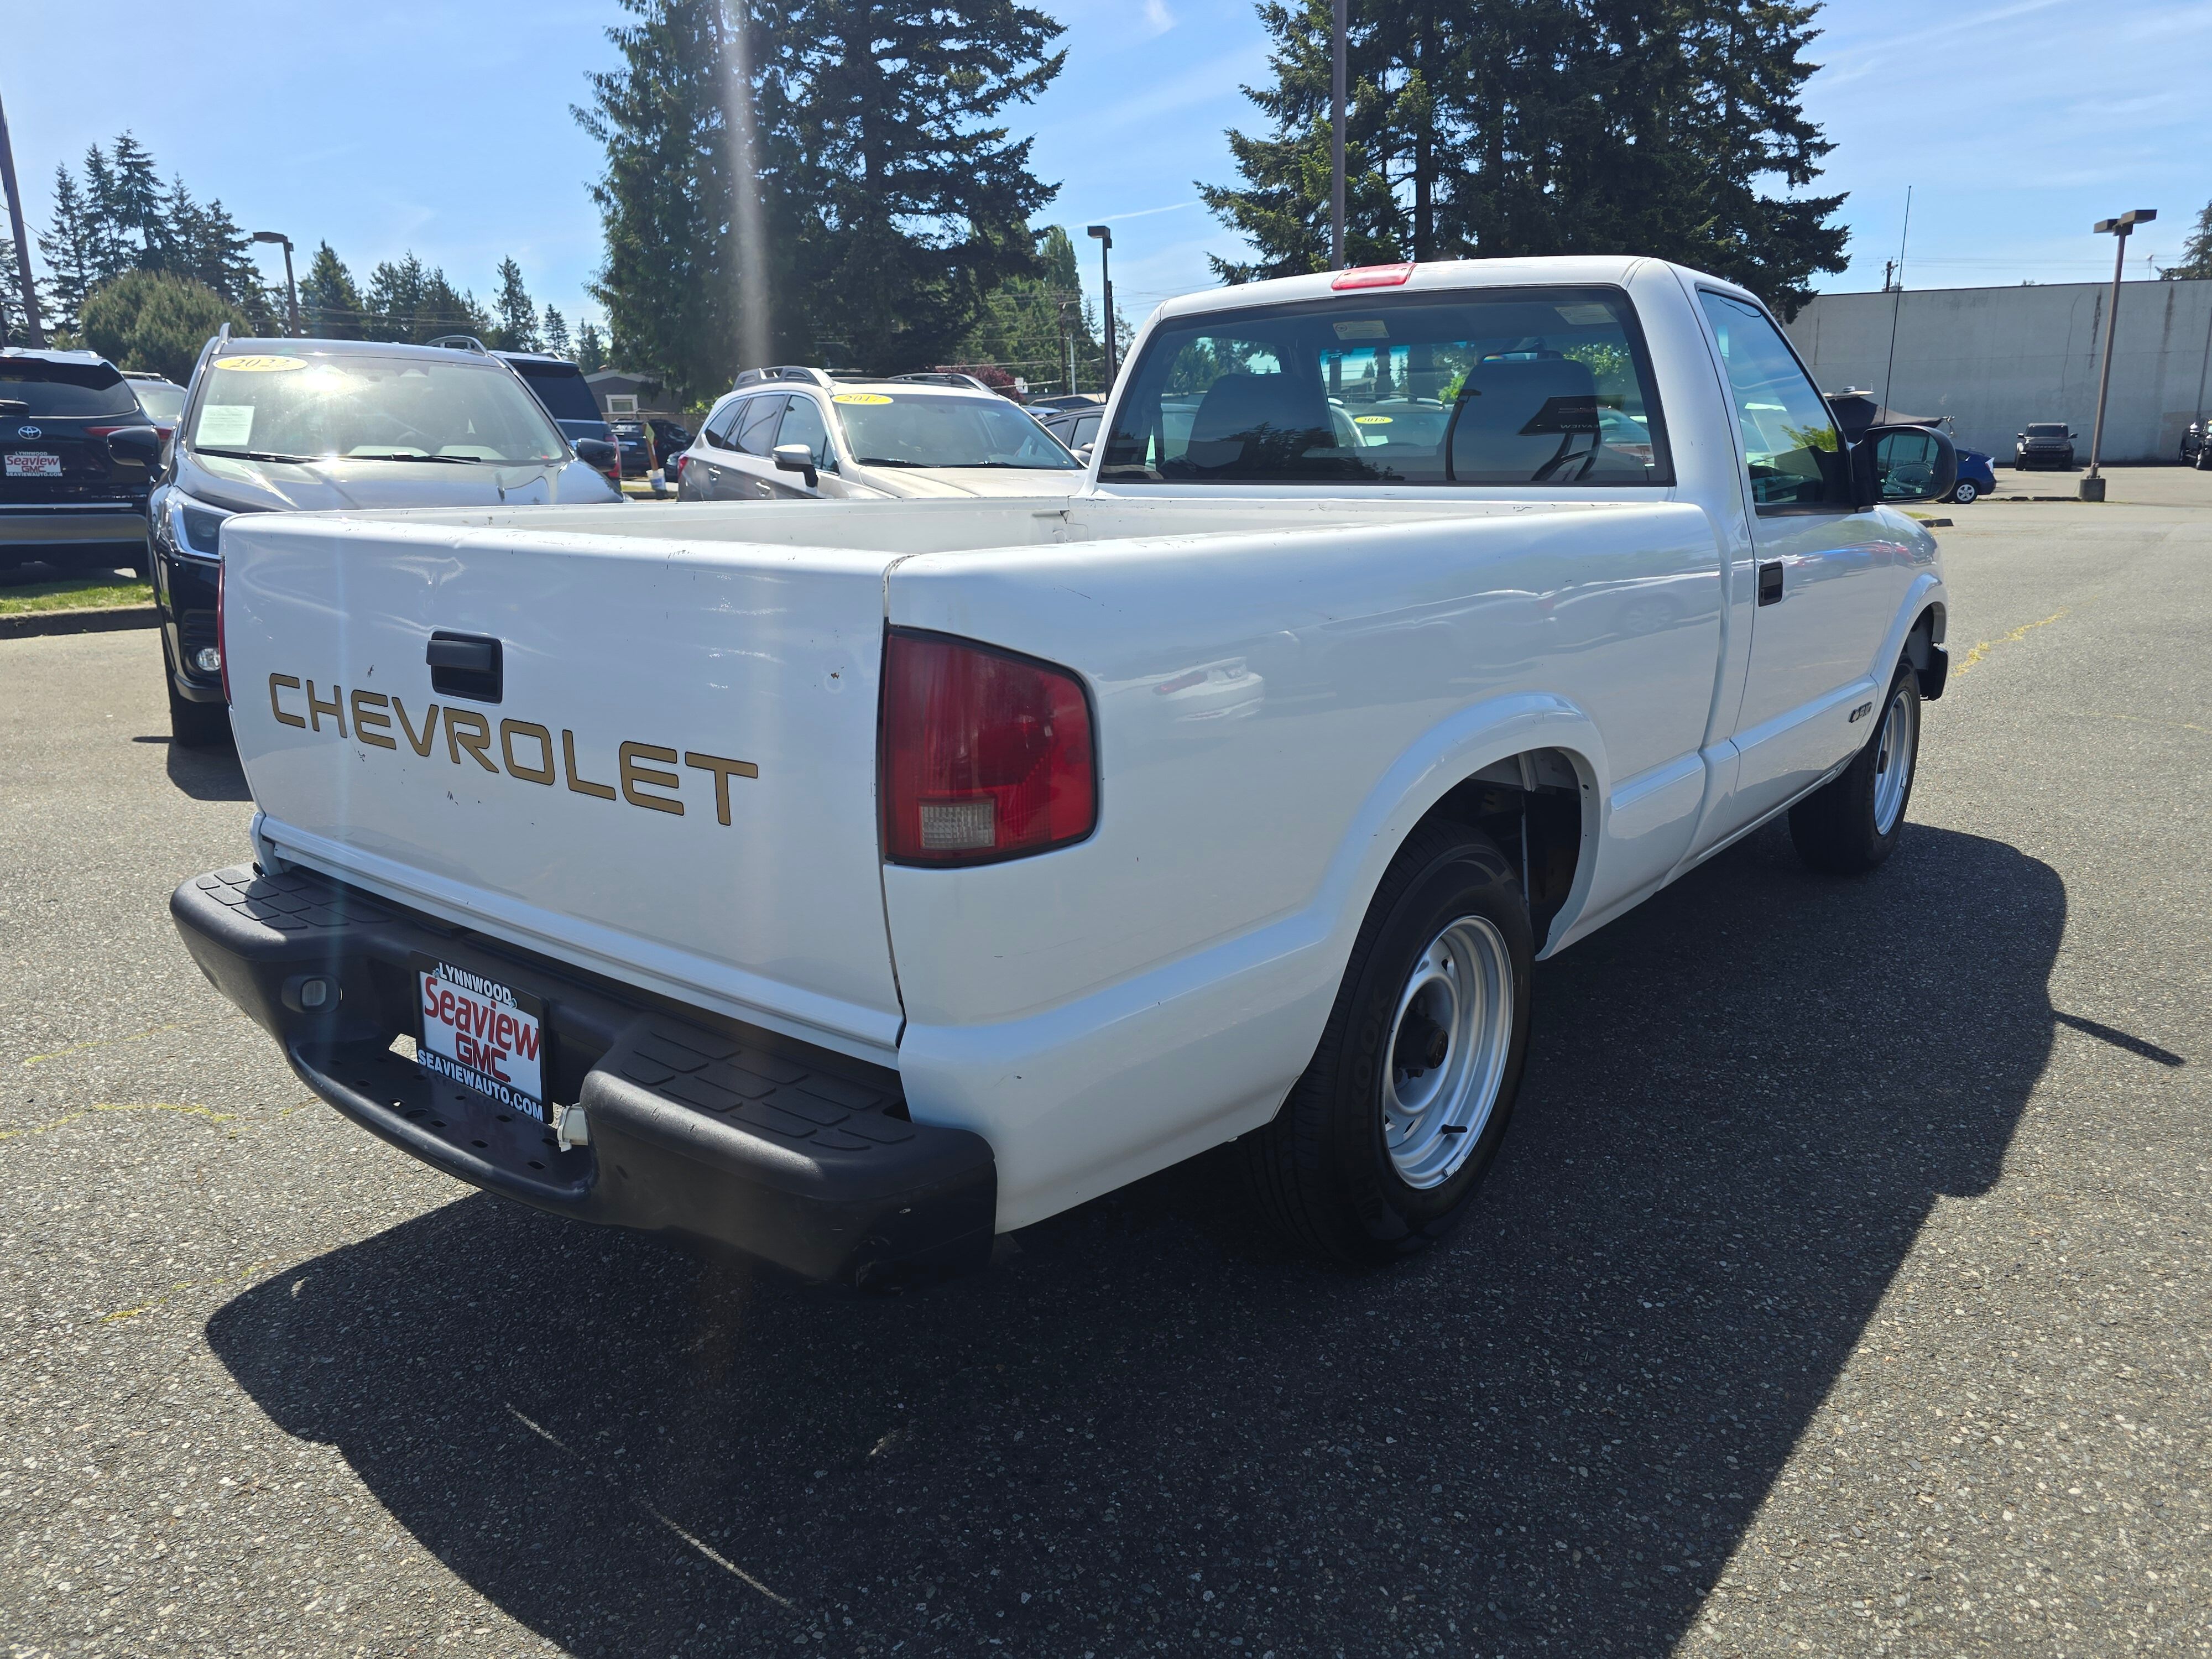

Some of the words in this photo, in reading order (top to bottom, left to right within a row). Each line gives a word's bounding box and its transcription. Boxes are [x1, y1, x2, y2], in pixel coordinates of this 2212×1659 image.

[7, 456, 59, 465] Seaview
[269, 672, 758, 826] CHEVROLET
[439, 962, 512, 1004] LYNNWOOD
[425, 975, 540, 1061] Seaview
[418, 1050, 543, 1122] SEAVIEWAUTO.COM
[456, 1031, 510, 1082] GMC
